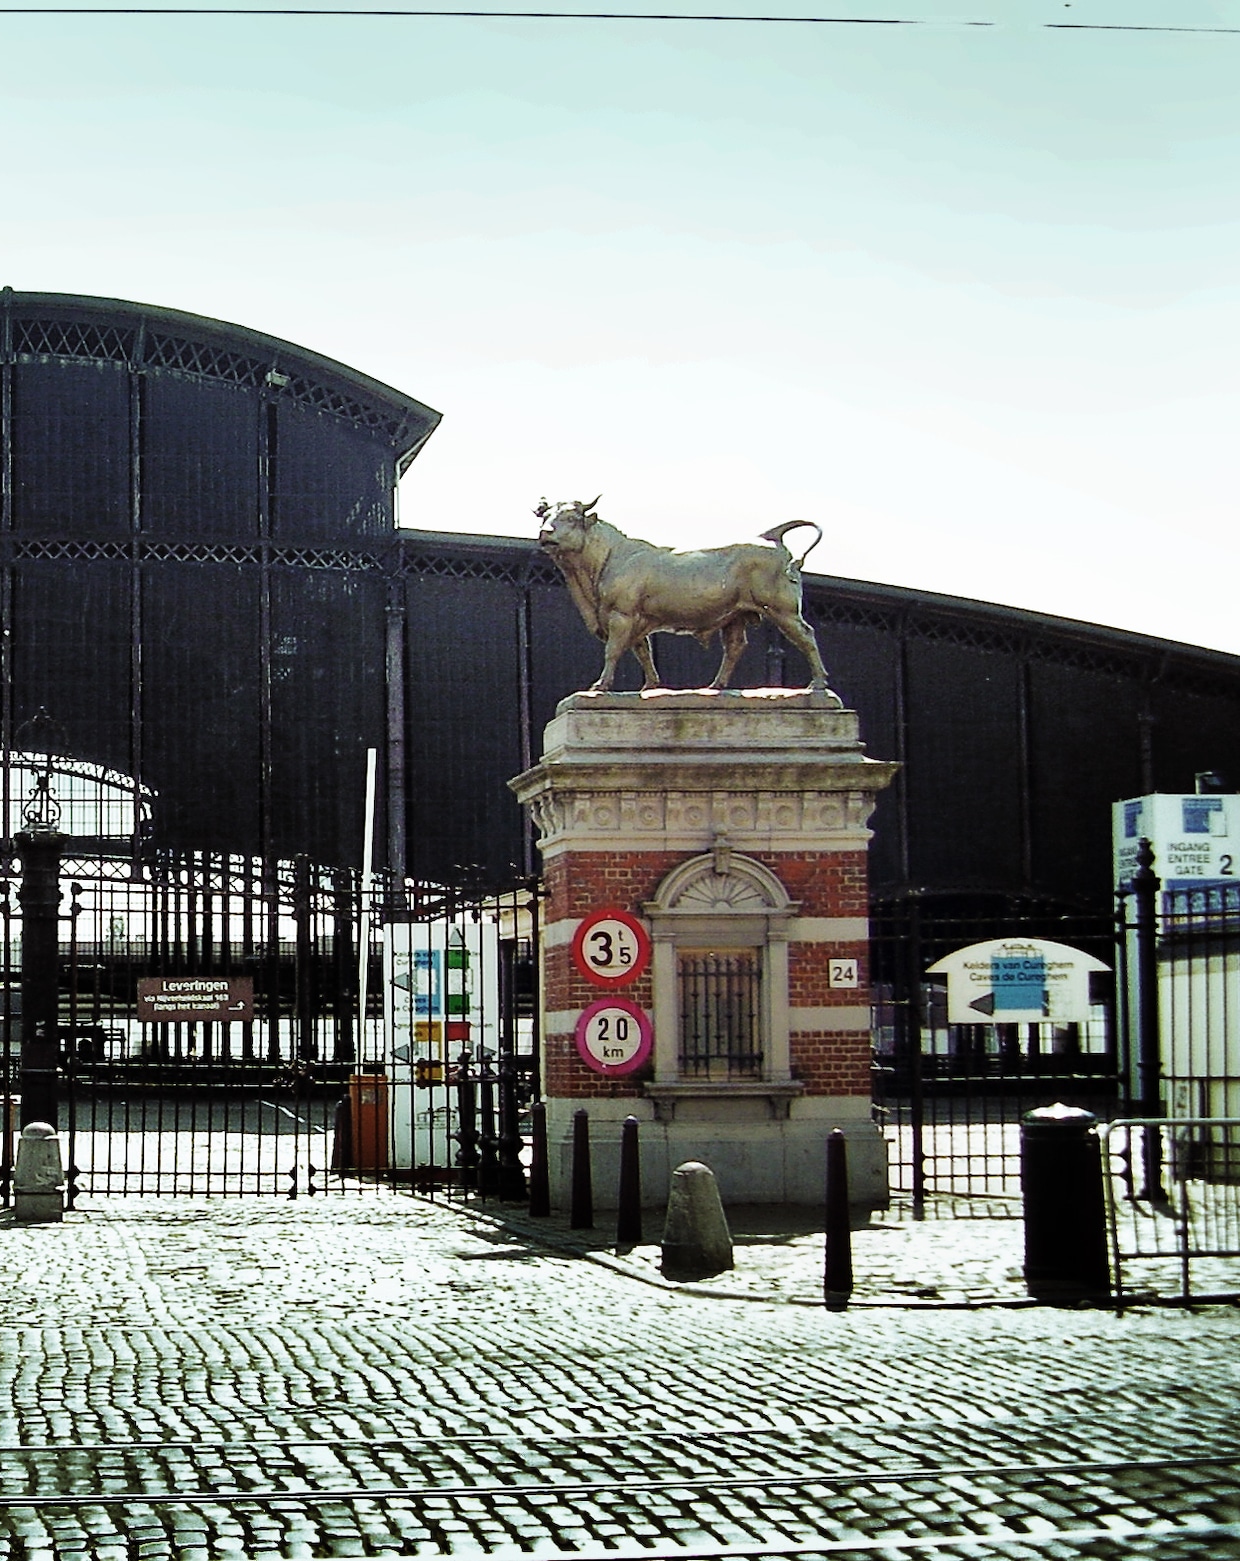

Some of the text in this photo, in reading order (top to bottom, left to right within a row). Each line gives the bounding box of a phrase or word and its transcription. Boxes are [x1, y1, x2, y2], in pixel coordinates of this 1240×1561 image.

[1167, 843, 1210, 851] INGANG
[1168, 854, 1210, 863] ENTREE
[1220, 854, 1233, 875] 2
[1175, 866, 1203, 875] GATE
[963, 961, 1074, 971] Kelders van Cureghem
[833, 966, 853, 981] 24
[969, 973, 1068, 983] Caves de Cureghem
[162, 980, 229, 992] Leveringen
[598, 1017, 628, 1041] 20
[603, 1046, 624, 1058] km
